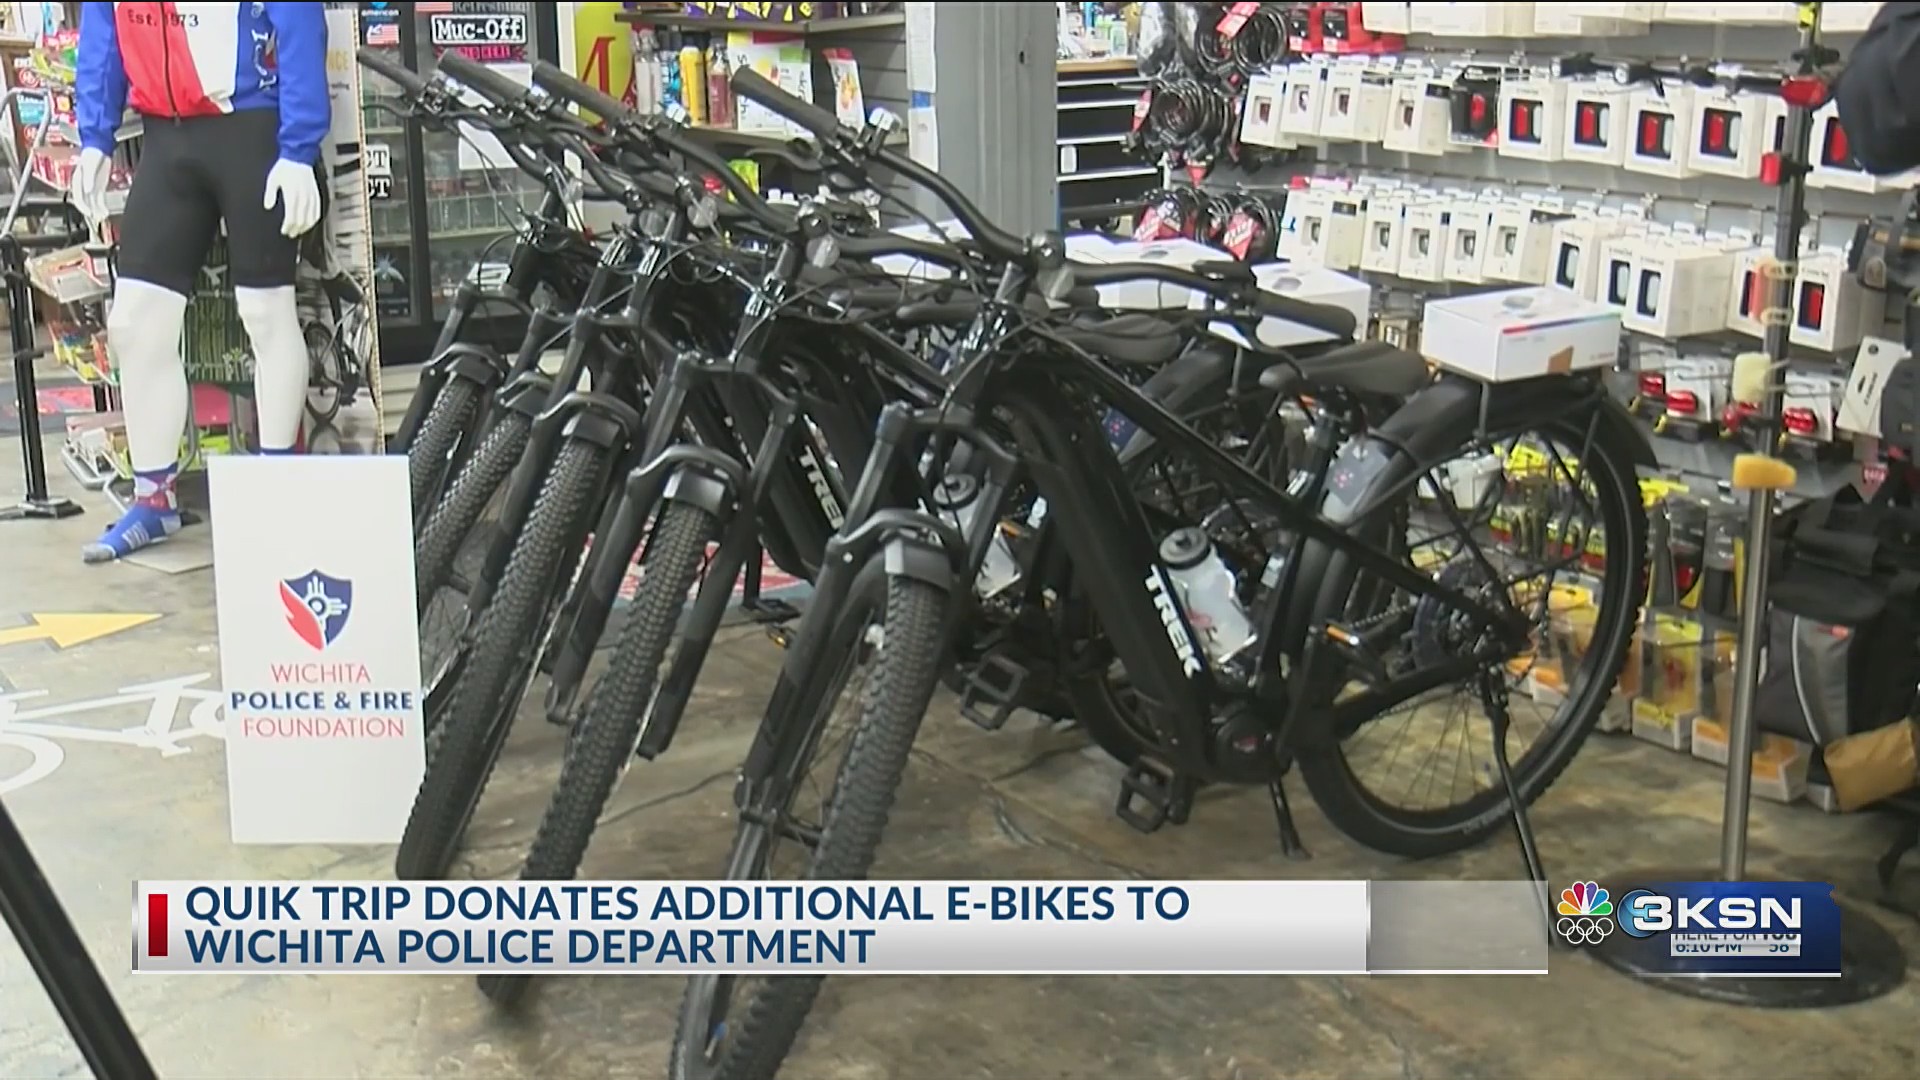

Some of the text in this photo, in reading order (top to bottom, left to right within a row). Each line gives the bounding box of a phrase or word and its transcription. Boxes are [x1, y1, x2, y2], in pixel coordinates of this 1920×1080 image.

[127, 9, 157, 26] Est.
[436, 17, 521, 41] Muc-Off
[1145, 563, 1202, 679] TREK
[271, 663, 371, 683] WICHITA
[231, 691, 413, 710] POLICE & FIRE
[243, 717, 404, 737] FOUNDATION
